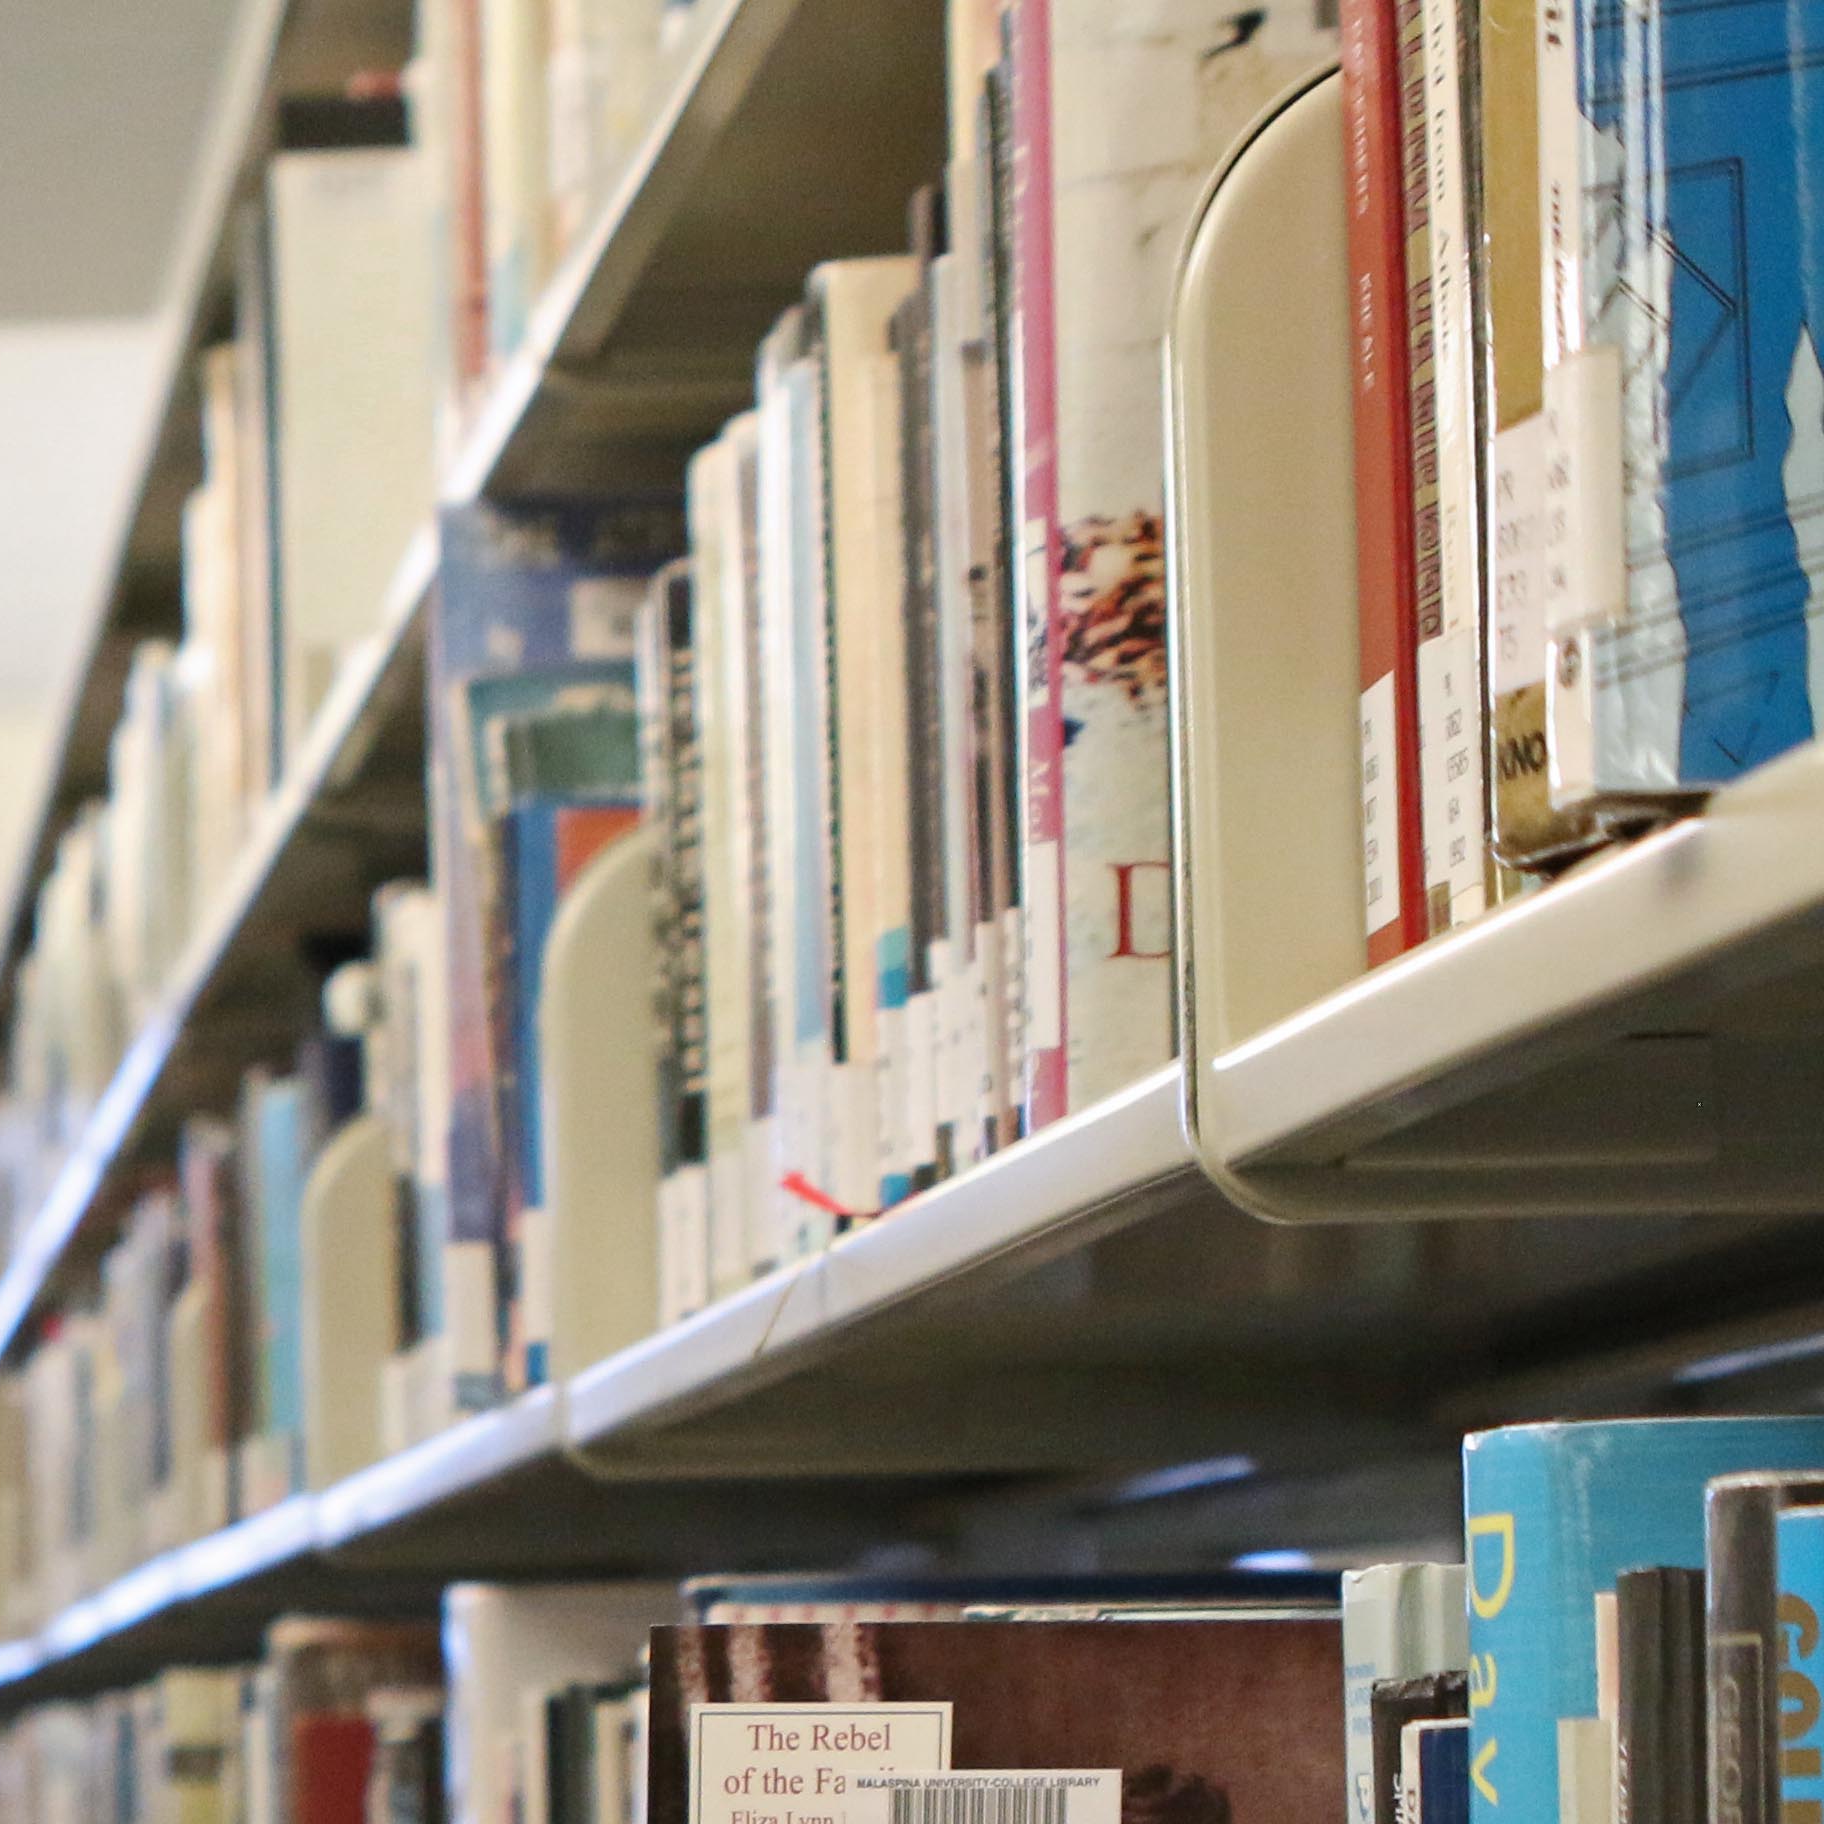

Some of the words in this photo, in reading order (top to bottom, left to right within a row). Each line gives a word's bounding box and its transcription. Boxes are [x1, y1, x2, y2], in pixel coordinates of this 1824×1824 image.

[747, 1724, 801, 1752] The
[811, 1723, 893, 1752] Rebel
[723, 1766, 758, 1795] of
[762, 1767, 804, 1795] the
[856, 1776, 920, 1789] MALASPINA
[924, 1777, 1048, 1788] UNIVERSITY-COLLEGE
[1050, 1777, 1101, 1788] LIBRARY
